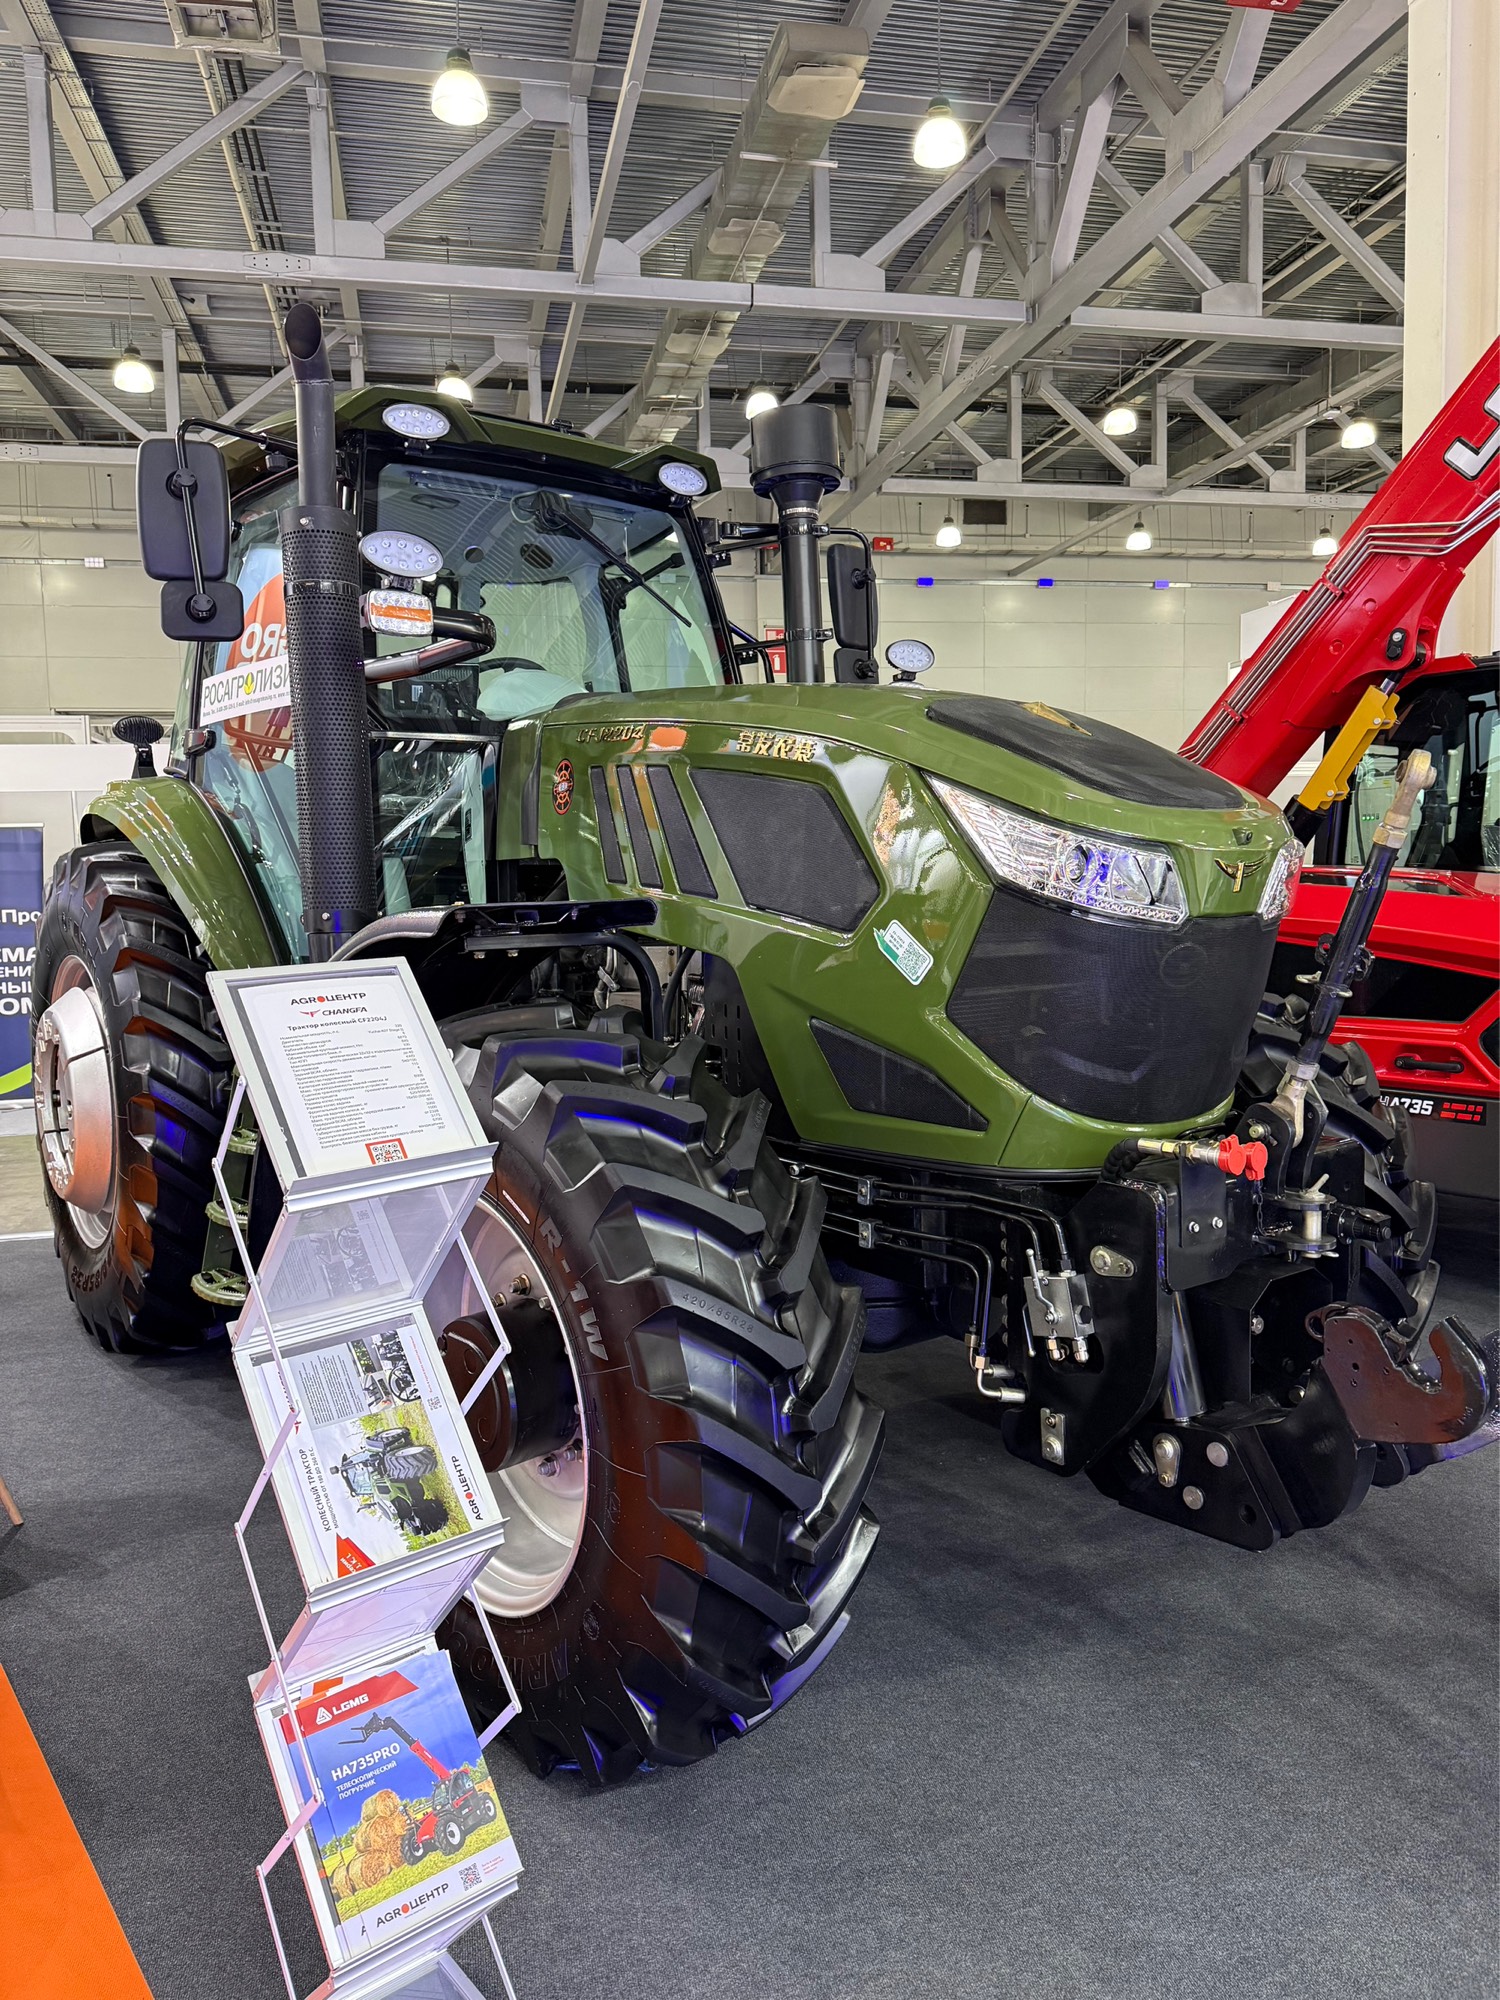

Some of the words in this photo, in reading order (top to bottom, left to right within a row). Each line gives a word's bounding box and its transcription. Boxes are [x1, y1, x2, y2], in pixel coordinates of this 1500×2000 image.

[287, 1023, 320, 1032] Трактор
[319, 1019, 357, 1028] колесный
[321, 1006, 368, 1016] CHANGFA
[539, 1216, 609, 1361] R-1W
[682, 1292, 754, 1333] 420/85R28
[298, 1447, 317, 1486] ТРАКТОР
[314, 1466, 322, 1476] ДО
[320, 1484, 327, 1493] ОТ
[309, 1485, 332, 1533] КОЛЕСНЫЙ
[323, 1492, 340, 1530] МОЩНОСТЬЮ
[331, 1693, 370, 1716] LGMG
[330, 1743, 402, 1782] HA735PRO
[336, 1759, 398, 1793] ТЕЛЕСКОПИЧЕСКИЙ
[337, 1779, 377, 1801] ПОГРУЗЧИК
